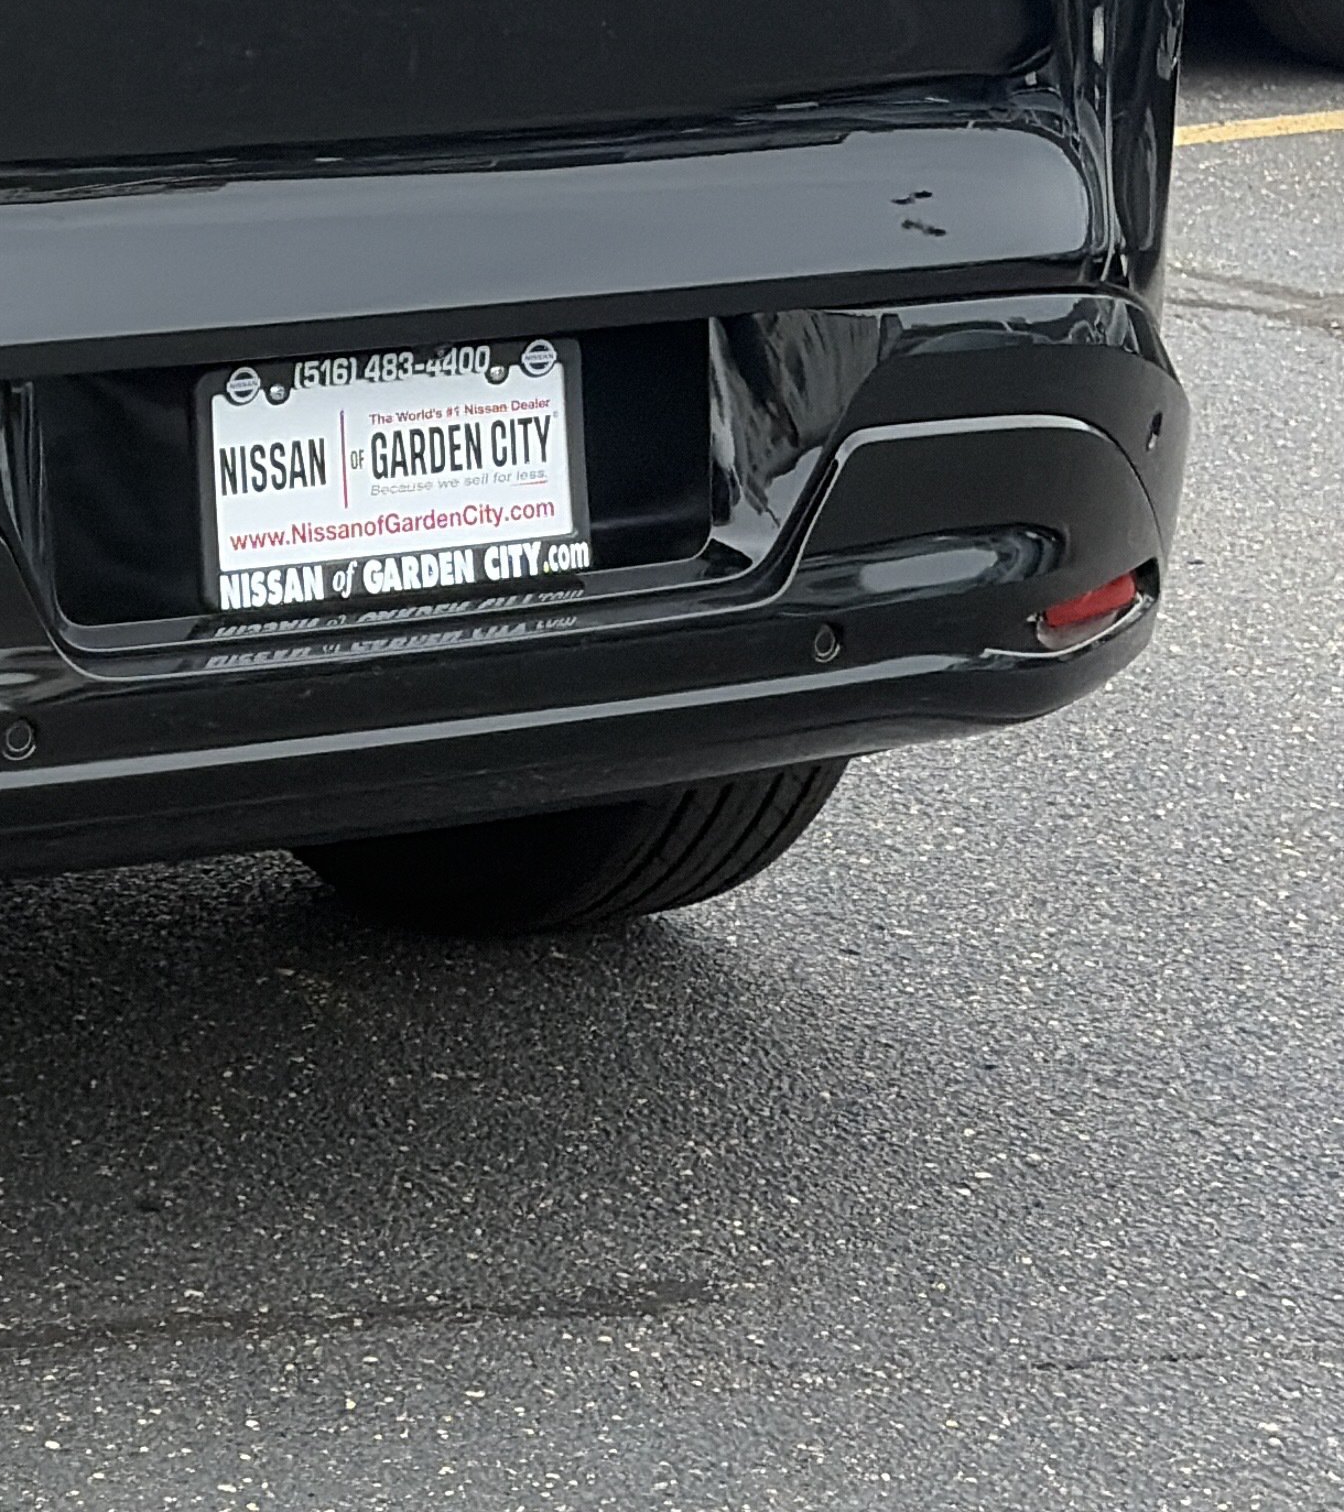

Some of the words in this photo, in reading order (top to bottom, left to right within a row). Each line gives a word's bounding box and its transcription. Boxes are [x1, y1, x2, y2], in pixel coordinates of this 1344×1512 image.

[293, 356, 358, 389] (516)
[364, 345, 491, 383] 483-4400
[369, 412, 393, 425] The
[395, 408, 443, 423] World's
[446, 406, 460, 418] #1
[464, 403, 508, 416] Nissan
[511, 398, 551, 412] Dealer
[219, 438, 327, 497] NISSAN
[350, 449, 365, 470] OF
[370, 422, 483, 480] GARDEN
[491, 415, 551, 467] CITY
[370, 481, 434, 497] Because
[437, 478, 460, 489] we
[464, 471, 489, 488] sell
[493, 470, 513, 484] for
[516, 468, 548, 482] less.
[229, 500, 556, 552] www.NissanofGardenCity.com
[219, 565, 324, 610] NISSAN
[332, 560, 357, 599] of
[362, 549, 476, 595] GARDEN
[483, 541, 591, 581] CITY.com
